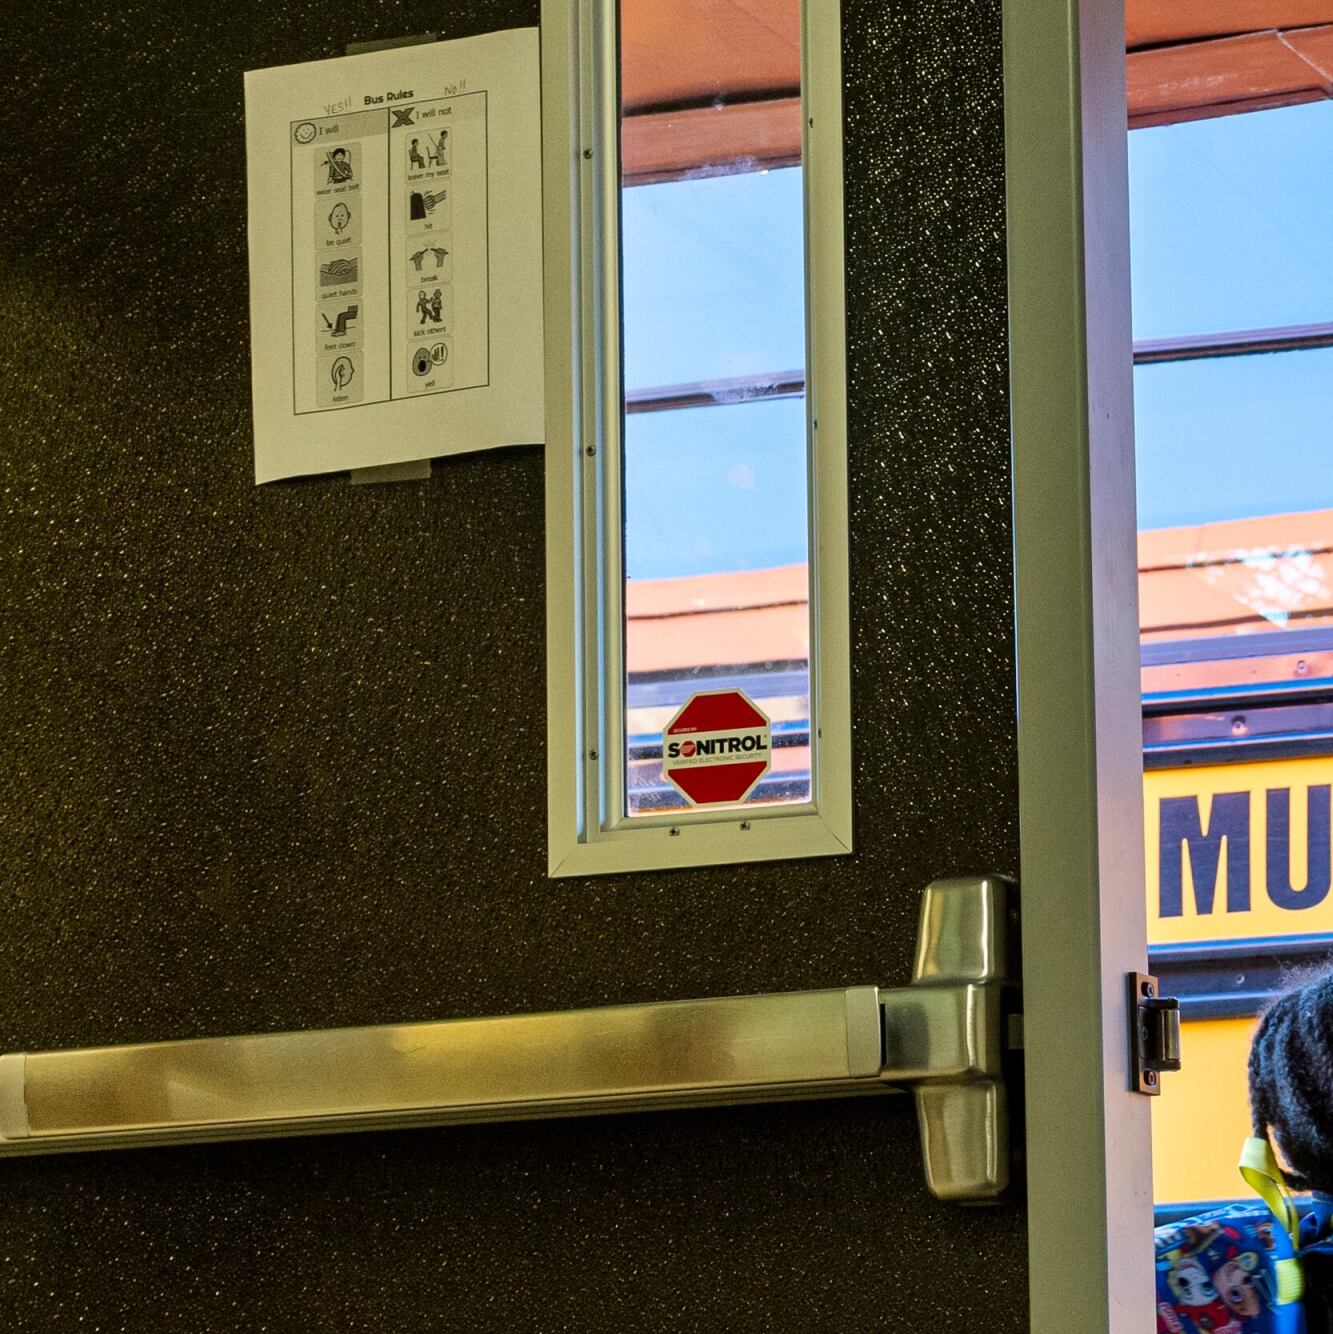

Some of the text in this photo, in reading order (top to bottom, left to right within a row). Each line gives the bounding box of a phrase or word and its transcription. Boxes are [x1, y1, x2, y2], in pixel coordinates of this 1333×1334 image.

[364, 89, 414, 105] Bus Rules
[421, 109, 436, 119] will
[438, 107, 452, 116] not
[325, 124, 339, 135] will
[326, 237, 351, 247] be quiet
[321, 291, 337, 301] quiet
